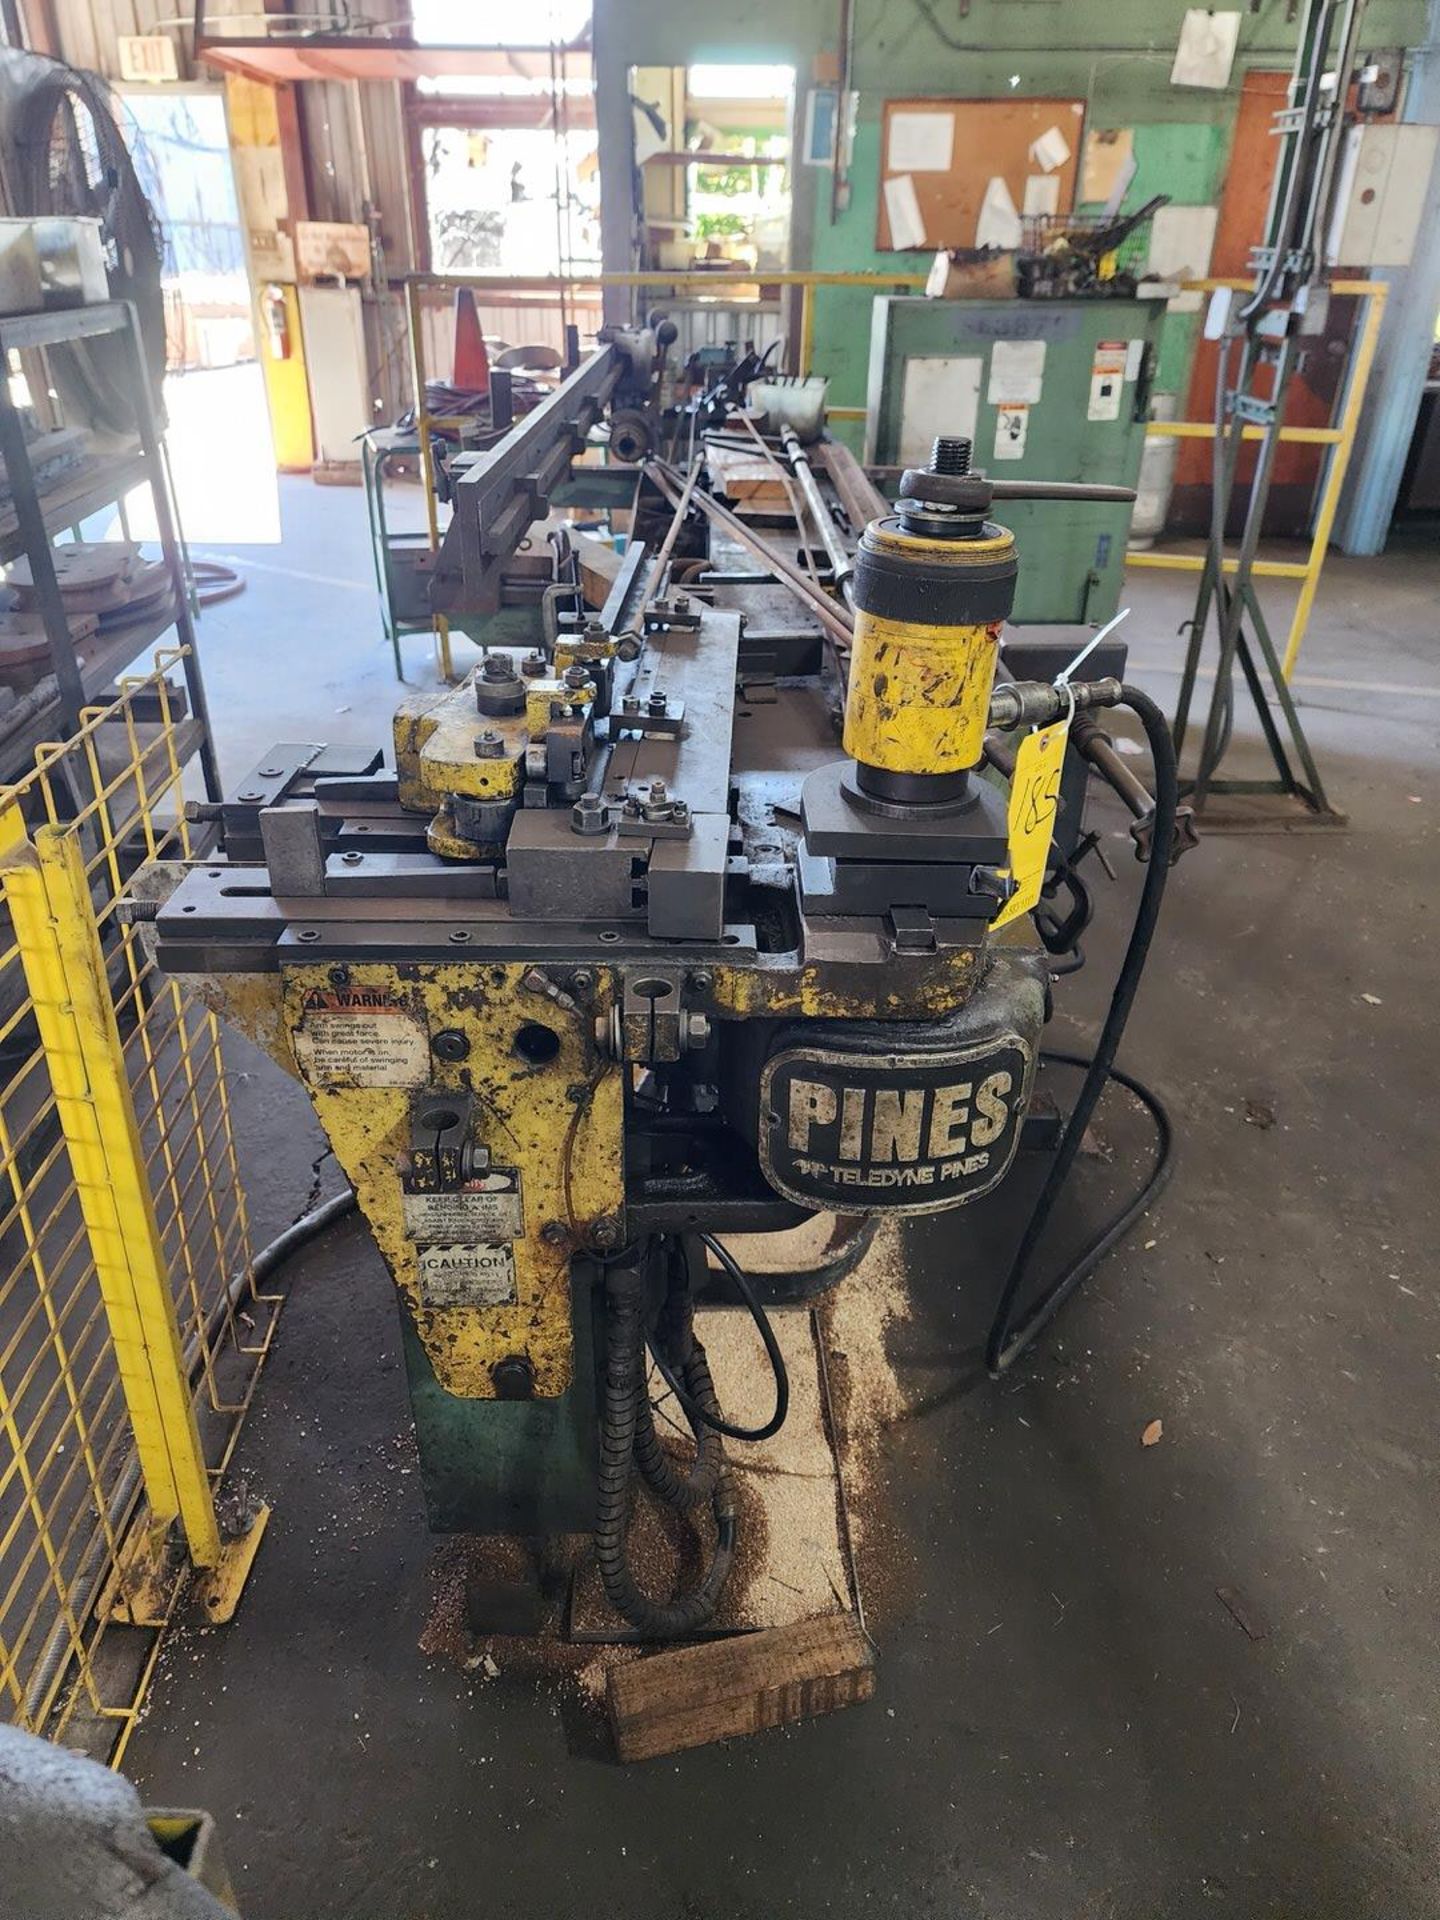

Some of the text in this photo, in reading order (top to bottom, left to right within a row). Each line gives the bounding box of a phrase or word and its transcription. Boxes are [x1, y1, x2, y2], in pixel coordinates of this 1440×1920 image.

[128, 39, 165, 73] EXIT
[1013, 768, 1060, 835] 185
[336, 993, 408, 1008] WARNIG
[371, 1057, 408, 1065] swinging
[787, 1071, 1012, 1163] PINES
[830, 1152, 990, 1187] TELEDYNE PINES
[427, 1257, 505, 1270] CAUTION
